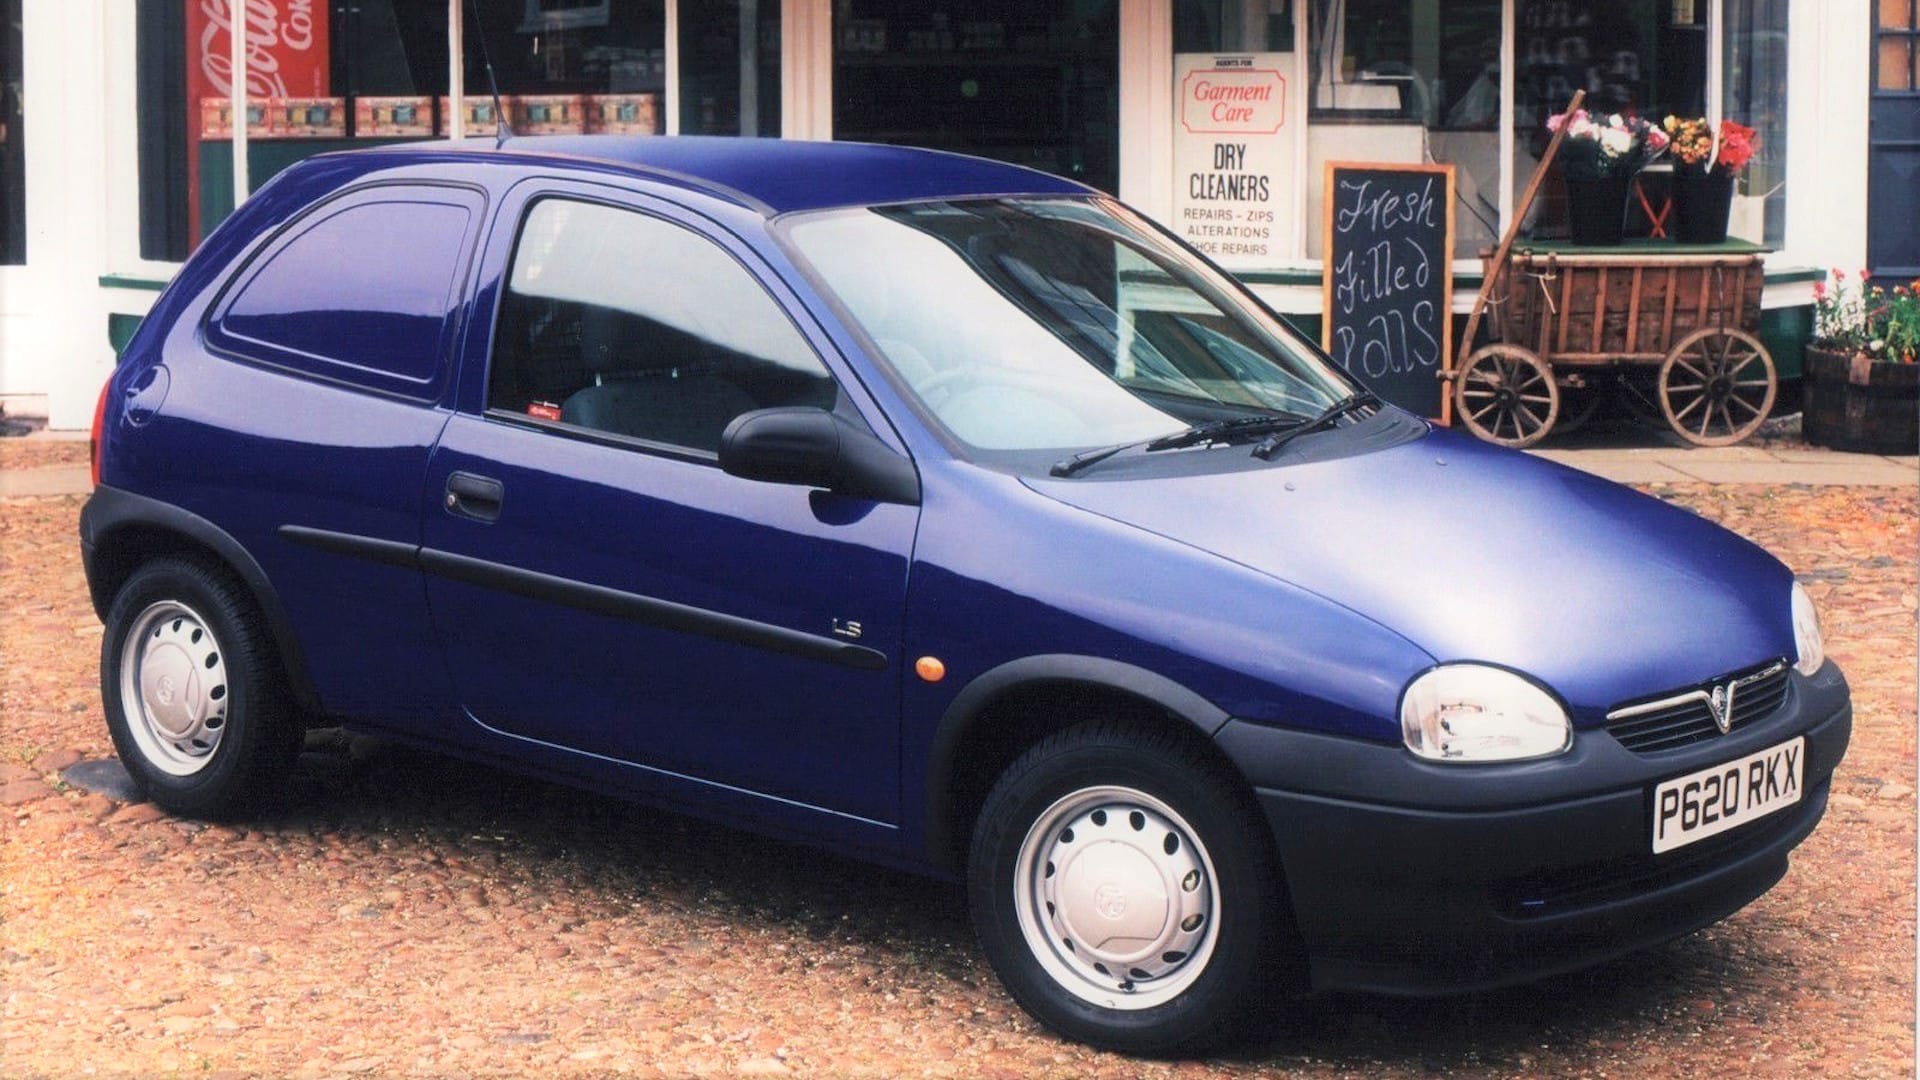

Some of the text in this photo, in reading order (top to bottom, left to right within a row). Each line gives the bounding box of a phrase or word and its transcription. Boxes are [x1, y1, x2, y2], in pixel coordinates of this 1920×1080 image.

[281, 0, 312, 50] Cok
[1194, 80, 1272, 101] Garment
[1212, 103, 1253, 122] Care
[1214, 143, 1246, 170] DRY
[1190, 173, 1269, 201] CLEANERS
[1184, 208, 1233, 221] REPAIRS
[1247, 210, 1274, 223] ZIPS
[1337, 178, 1435, 233] Fresh
[1187, 225, 1269, 238] ALTERATIONS
[1222, 242, 1268, 256] REPAIRS
[832, 617, 863, 638] LS
[1659, 745, 1799, 841] P620 RKX
